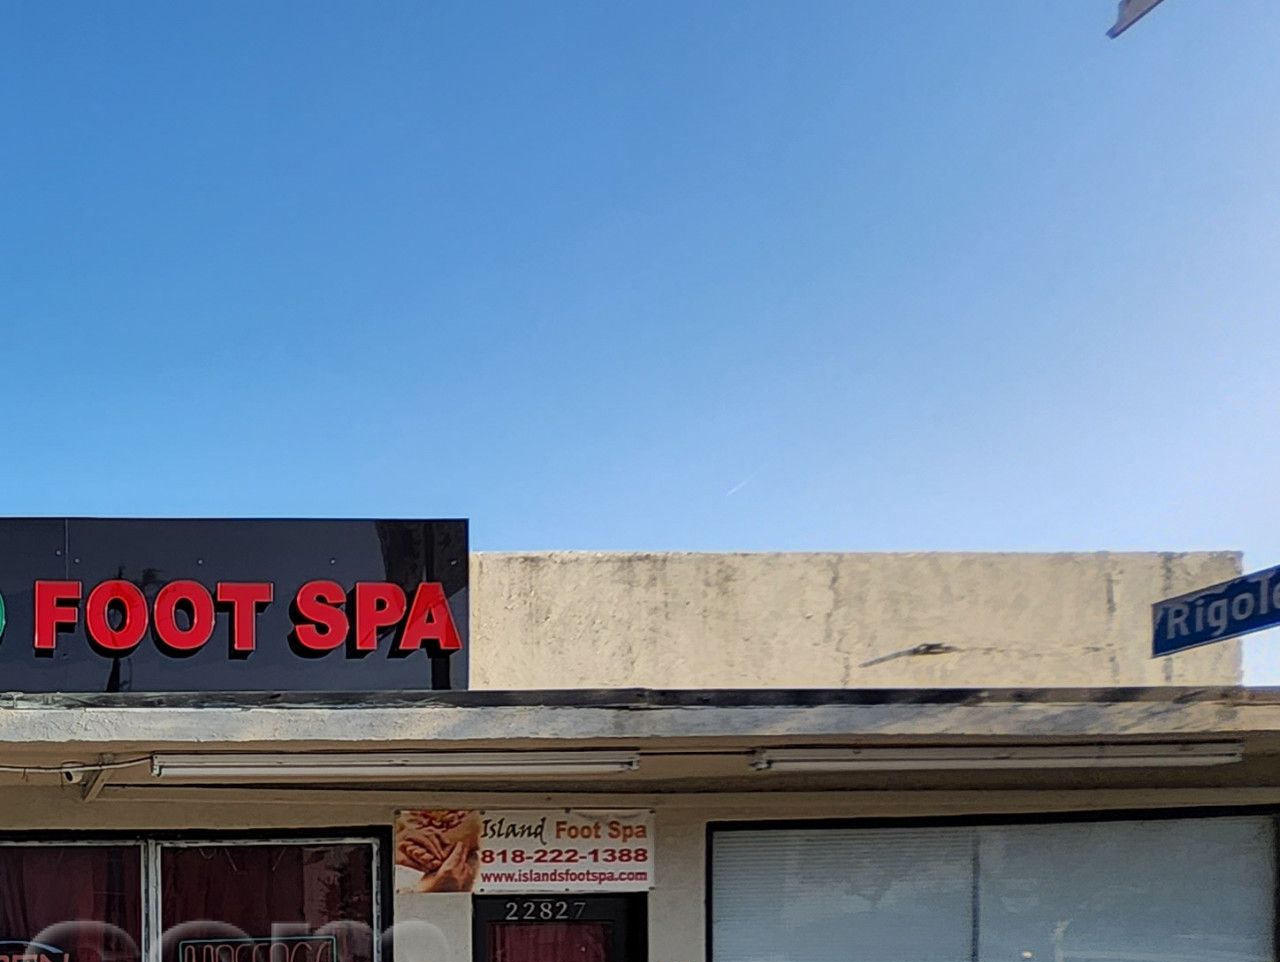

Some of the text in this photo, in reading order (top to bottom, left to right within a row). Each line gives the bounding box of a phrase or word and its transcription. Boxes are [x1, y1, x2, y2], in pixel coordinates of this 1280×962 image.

[33, 577, 275, 652] FOOT
[294, 577, 463, 652] SPA
[481, 817, 647, 844] Island Foot Spa
[481, 848, 648, 863] 818-222-1388
[481, 869, 648, 884] www.islandsfootspa.com
[506, 902, 586, 920] 22827
